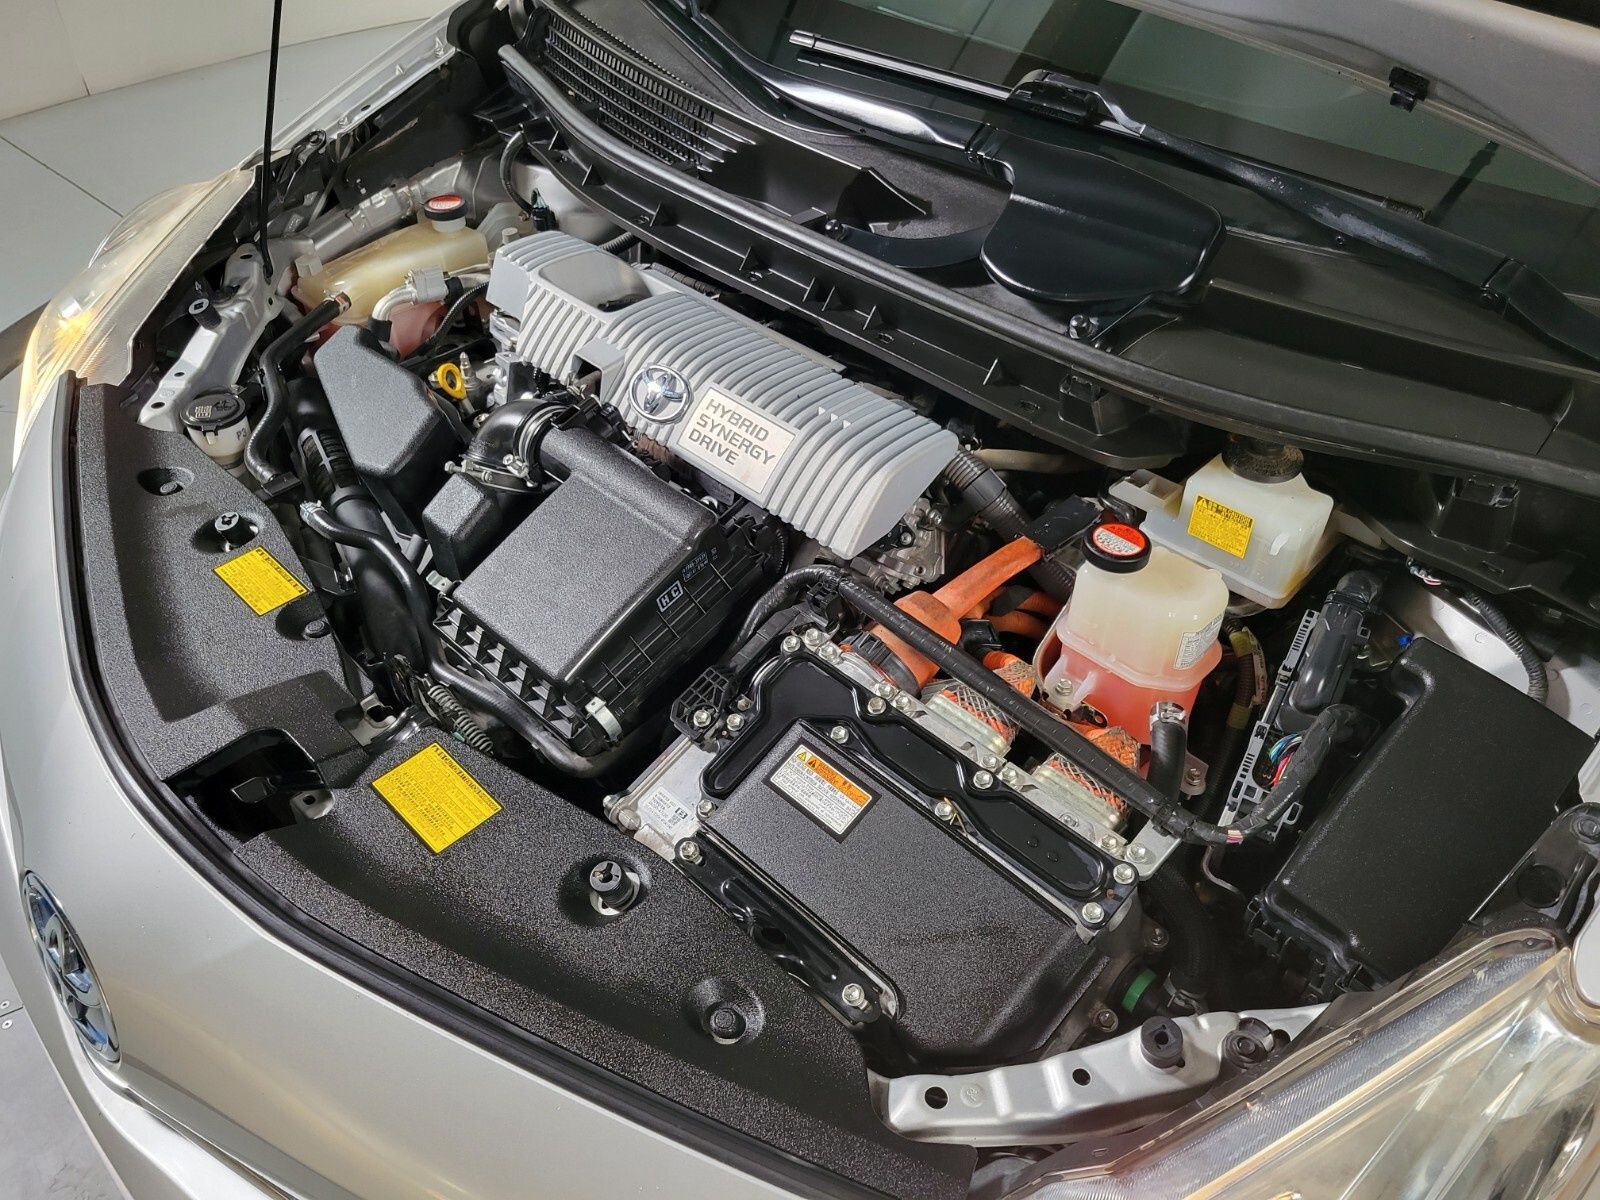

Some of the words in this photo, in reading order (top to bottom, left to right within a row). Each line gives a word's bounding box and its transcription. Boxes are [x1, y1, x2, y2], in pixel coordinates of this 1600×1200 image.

[696, 415, 776, 465] SYNERGY
[705, 399, 769, 442] HYBRID
[688, 431, 740, 466] DRIVE
